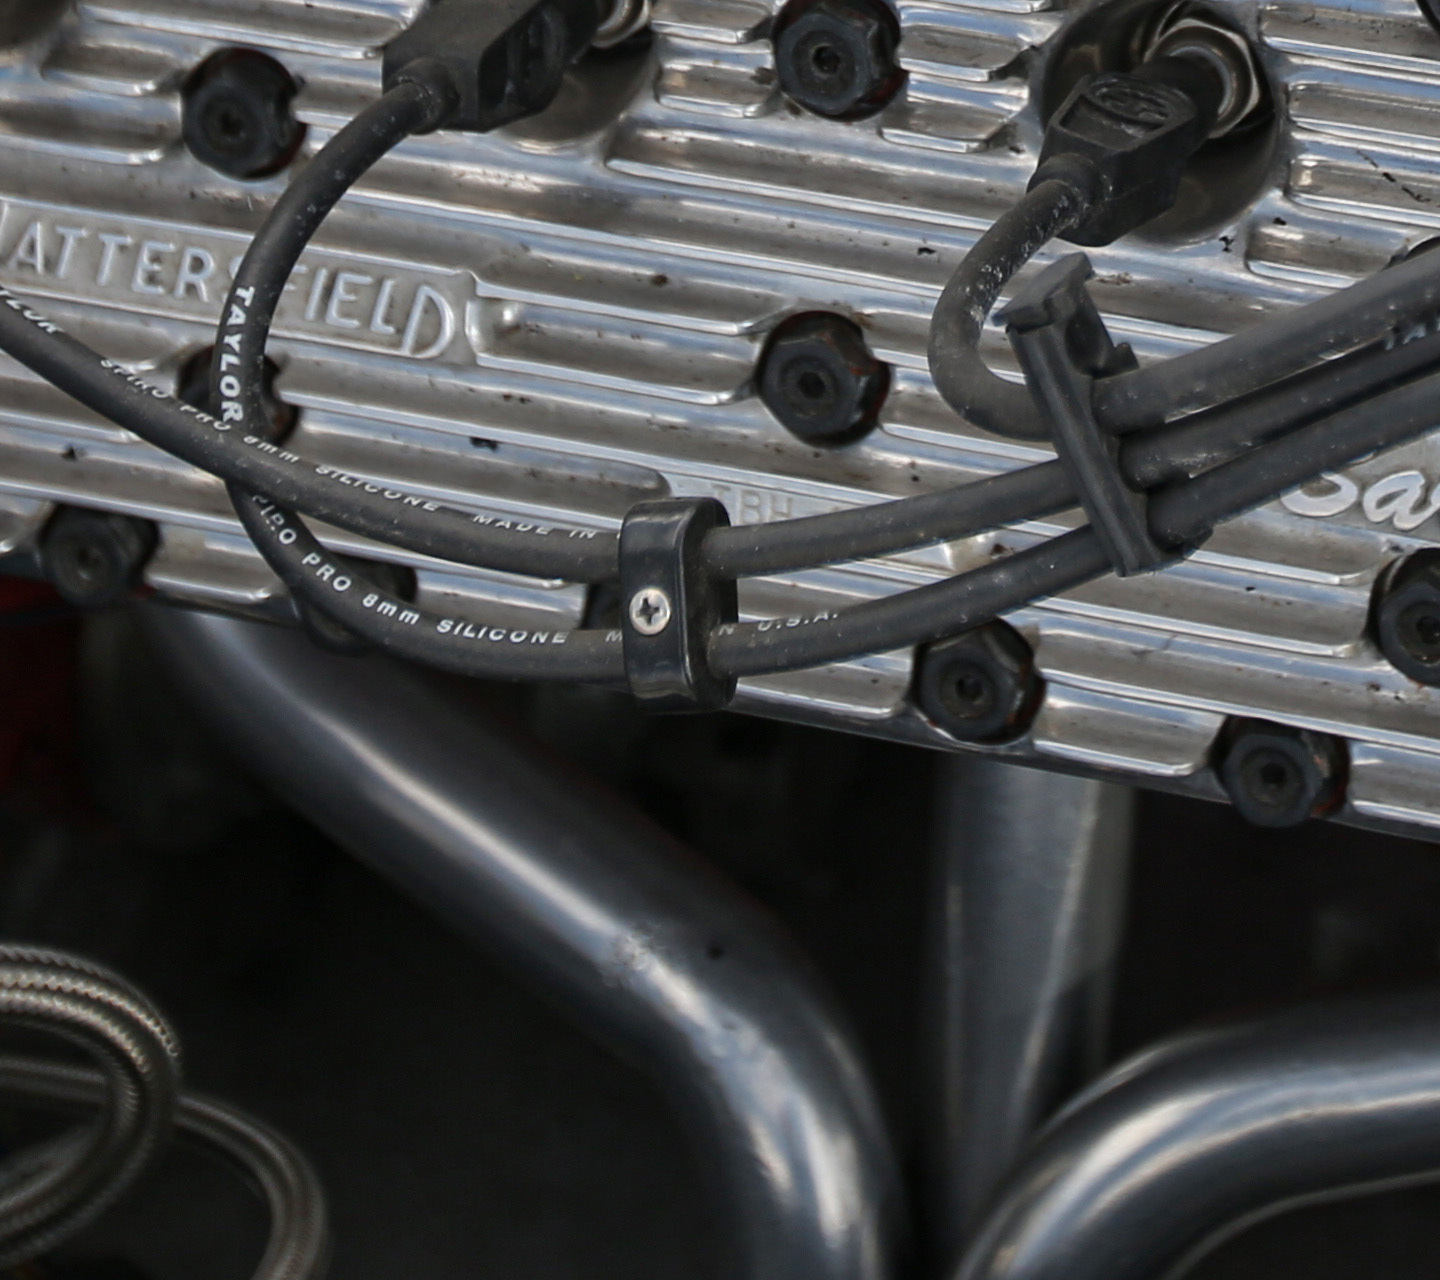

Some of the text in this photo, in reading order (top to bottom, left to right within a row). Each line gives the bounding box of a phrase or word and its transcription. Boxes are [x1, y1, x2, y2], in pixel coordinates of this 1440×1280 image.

[217, 284, 257, 424] TAYLOR
[300, 550, 353, 594] PRO
[360, 590, 422, 628] 8mm
[434, 617, 568, 647] SILICONE
